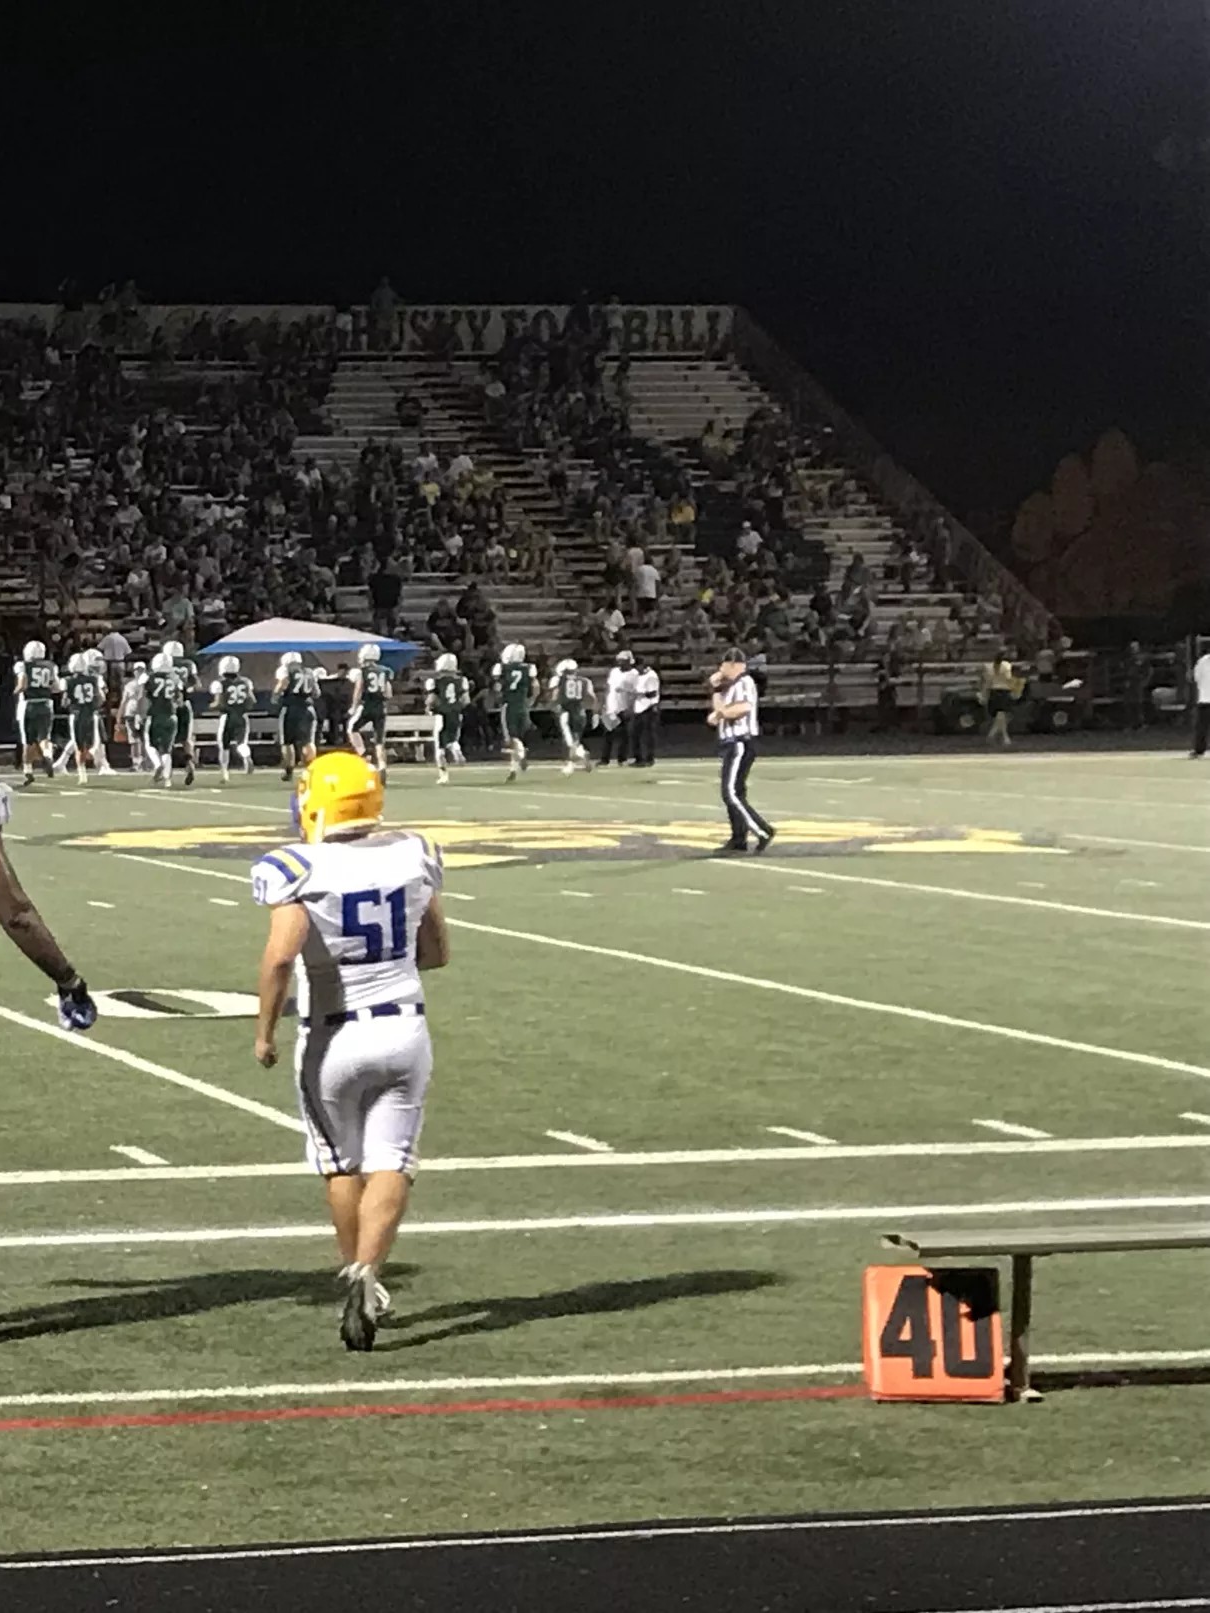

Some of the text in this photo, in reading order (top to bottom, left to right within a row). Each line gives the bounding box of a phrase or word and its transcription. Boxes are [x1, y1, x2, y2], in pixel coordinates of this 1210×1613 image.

[31, 667, 51, 688] 50
[153, 677, 176, 699] 72
[367, 671, 386, 692] 34
[511, 669, 523, 690] 7
[74, 683, 94, 703] 43
[227, 685, 248, 705] 35
[445, 682, 456, 704] 4
[340, 886, 407, 966] 51
[880, 1274, 995, 1379] 40
